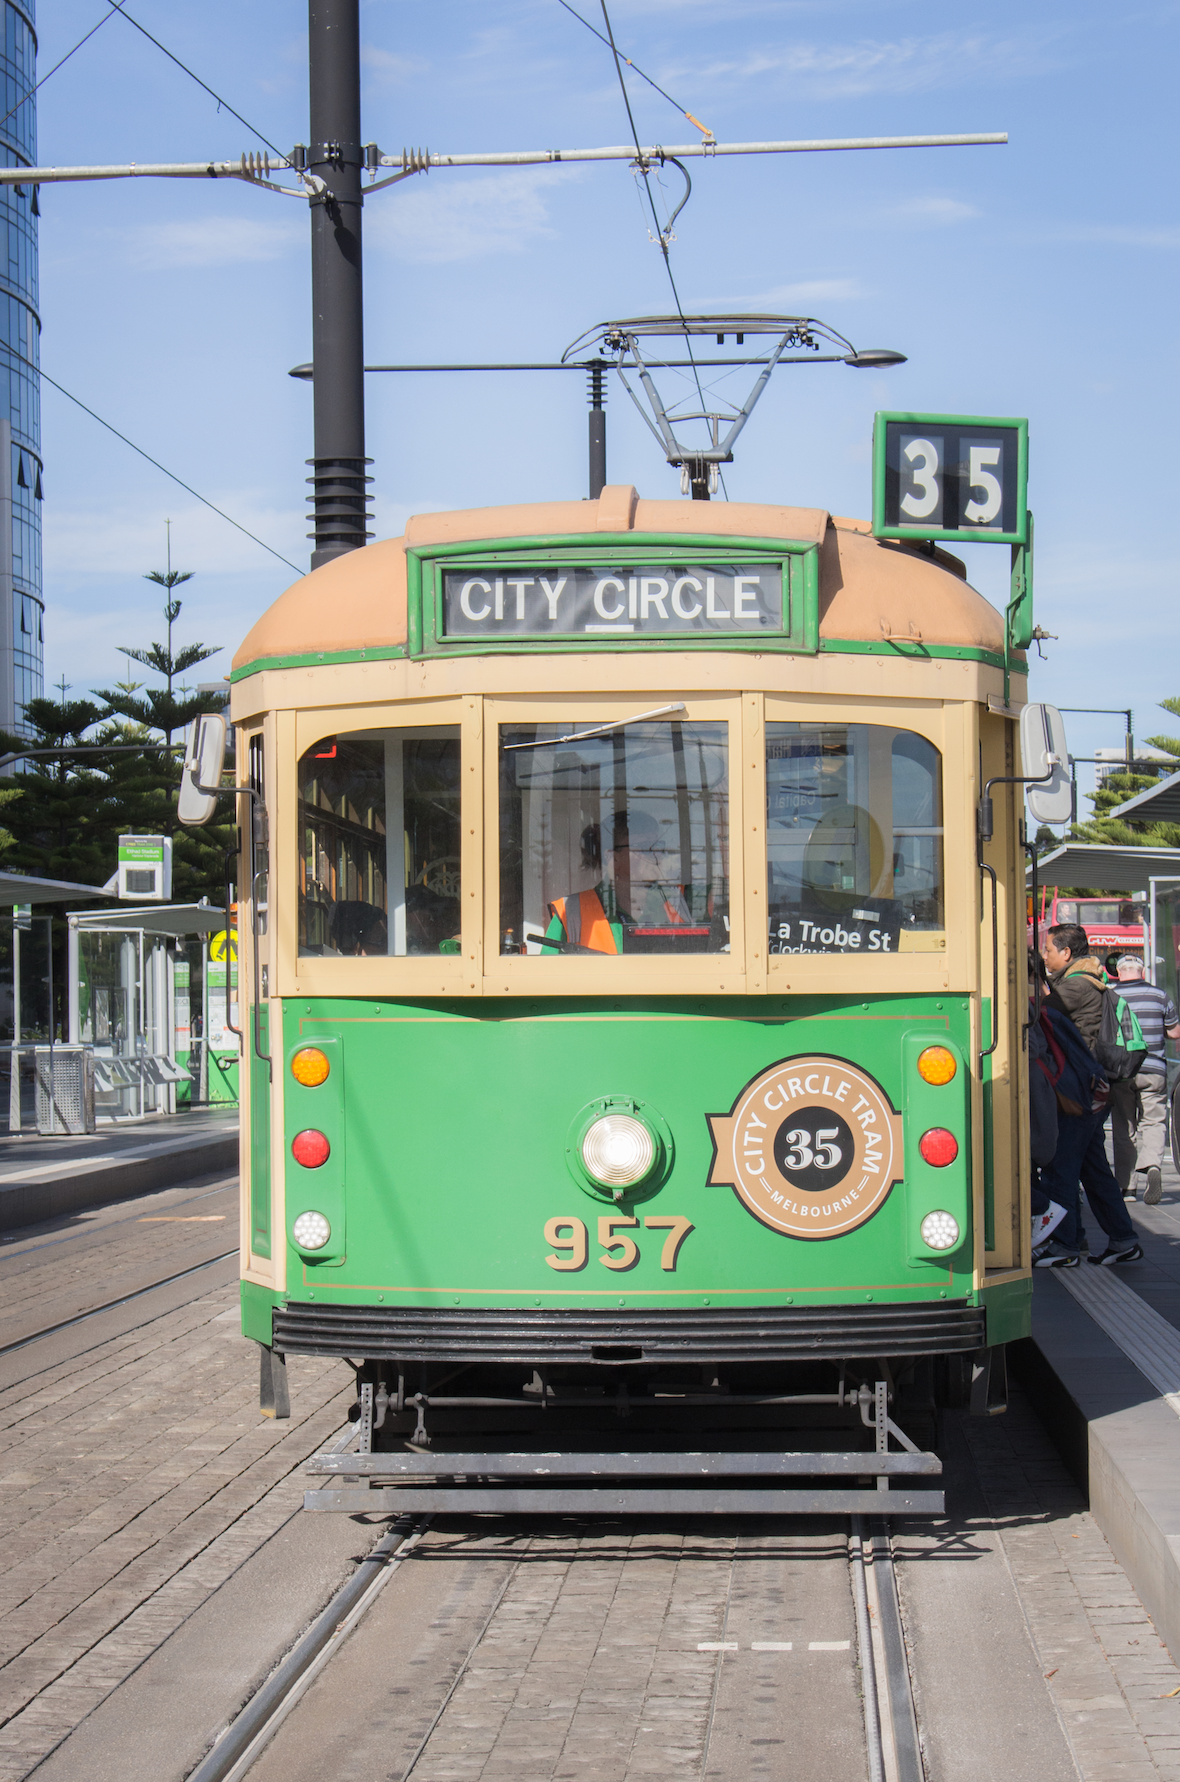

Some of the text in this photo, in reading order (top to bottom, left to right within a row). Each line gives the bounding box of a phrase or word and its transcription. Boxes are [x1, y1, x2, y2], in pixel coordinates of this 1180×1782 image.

[900, 438, 1002, 524] 35
[460, 576, 760, 620] CITY CIRCLE
[768, 917, 891, 951] La Trobe St
[743, 1074, 883, 1175] CITY CIRCLE TRAM
[784, 1127, 843, 1170] 35
[770, 1189, 860, 1217] MELBOURNE
[544, 1215, 696, 1272] 957
